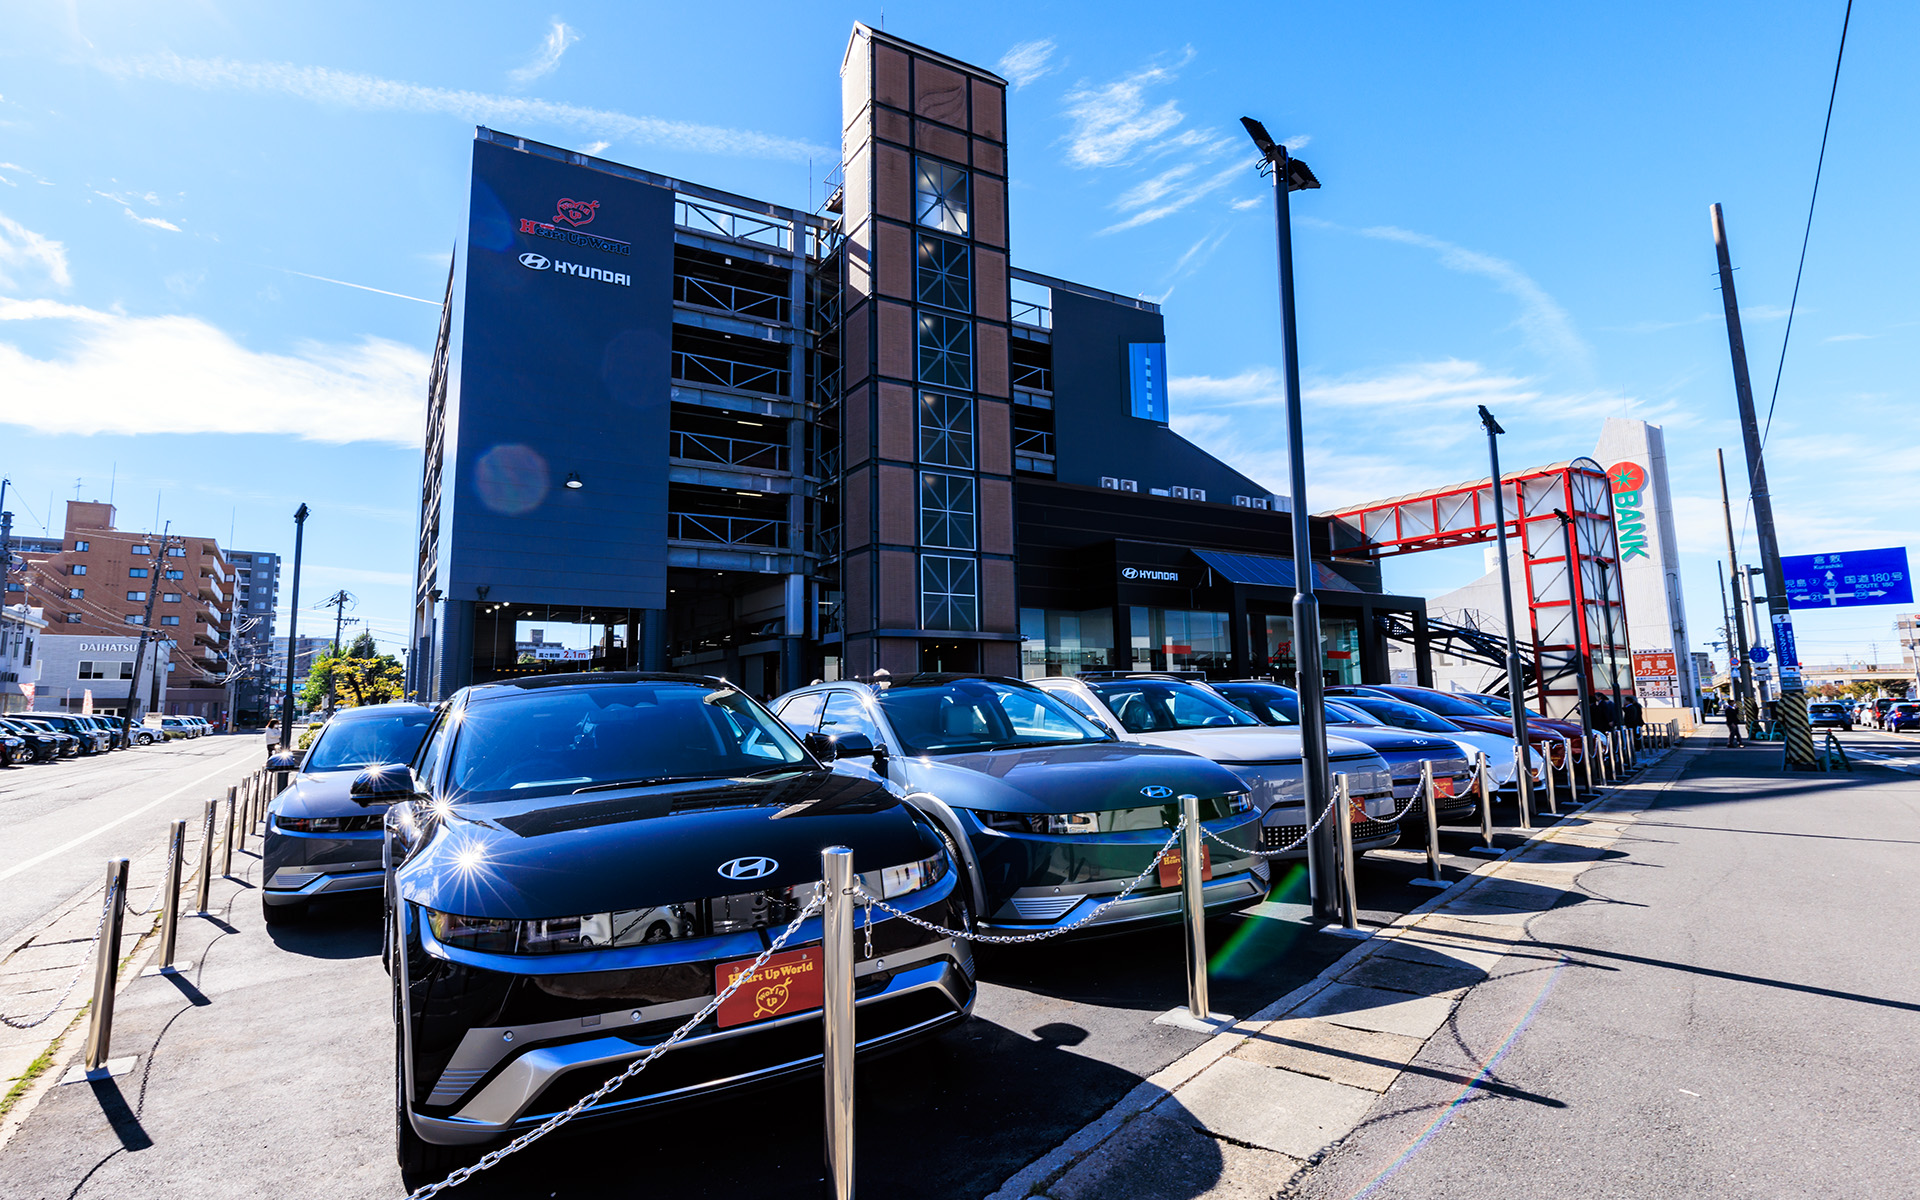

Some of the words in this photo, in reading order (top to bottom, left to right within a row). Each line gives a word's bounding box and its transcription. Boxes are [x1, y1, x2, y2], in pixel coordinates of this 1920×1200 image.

[520, 219, 565, 241] Heart
[568, 232, 588, 247] Up
[588, 238, 631, 255] World
[555, 260, 631, 286] HYUNDAI
[1614, 490, 1647, 561] BANK
[1139, 570, 1179, 581] HYUNDAI
[79, 643, 138, 652] DAIHATSU
[563, 650, 587, 659] 2.1m
[1635, 668, 1675, 676] クリニック
[765, 969, 780, 980] Up
[780, 962, 813, 977] World
[758, 988, 785, 1001] World
